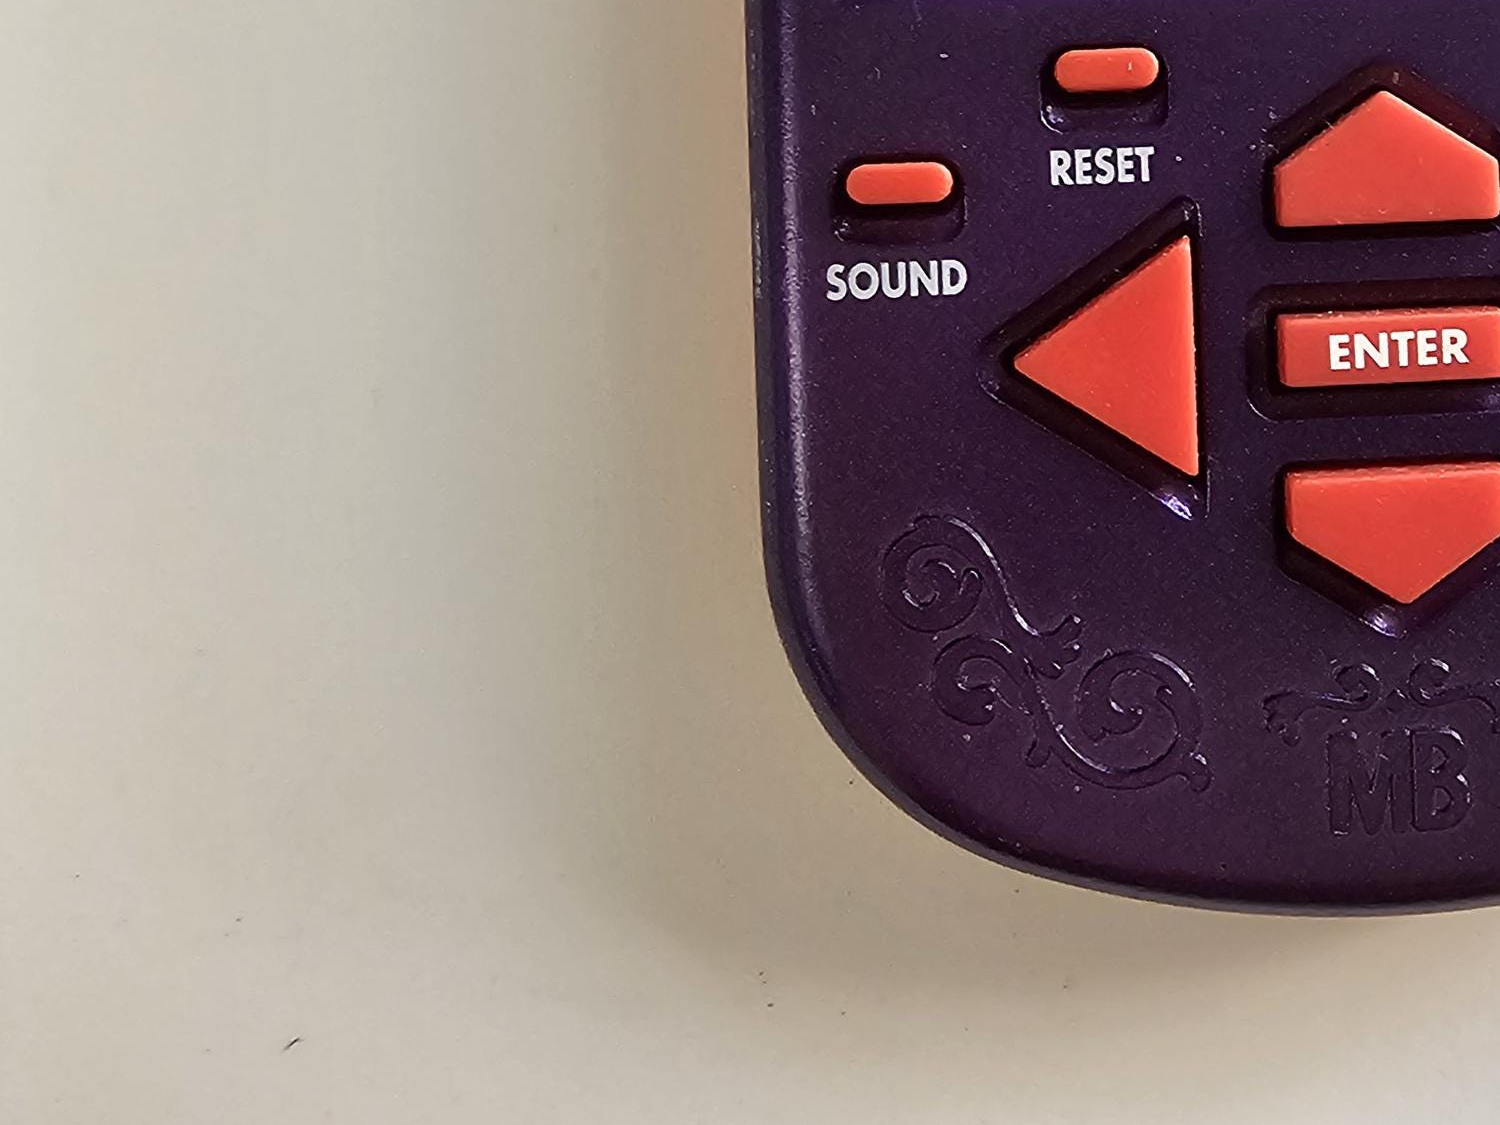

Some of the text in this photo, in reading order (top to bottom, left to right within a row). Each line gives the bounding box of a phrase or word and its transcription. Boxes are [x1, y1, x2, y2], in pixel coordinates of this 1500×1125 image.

[1049, 146, 1155, 186] RESET
[826, 258, 968, 302] SOUND
[1328, 327, 1470, 371] ENTER
[1325, 727, 1474, 836] MB
